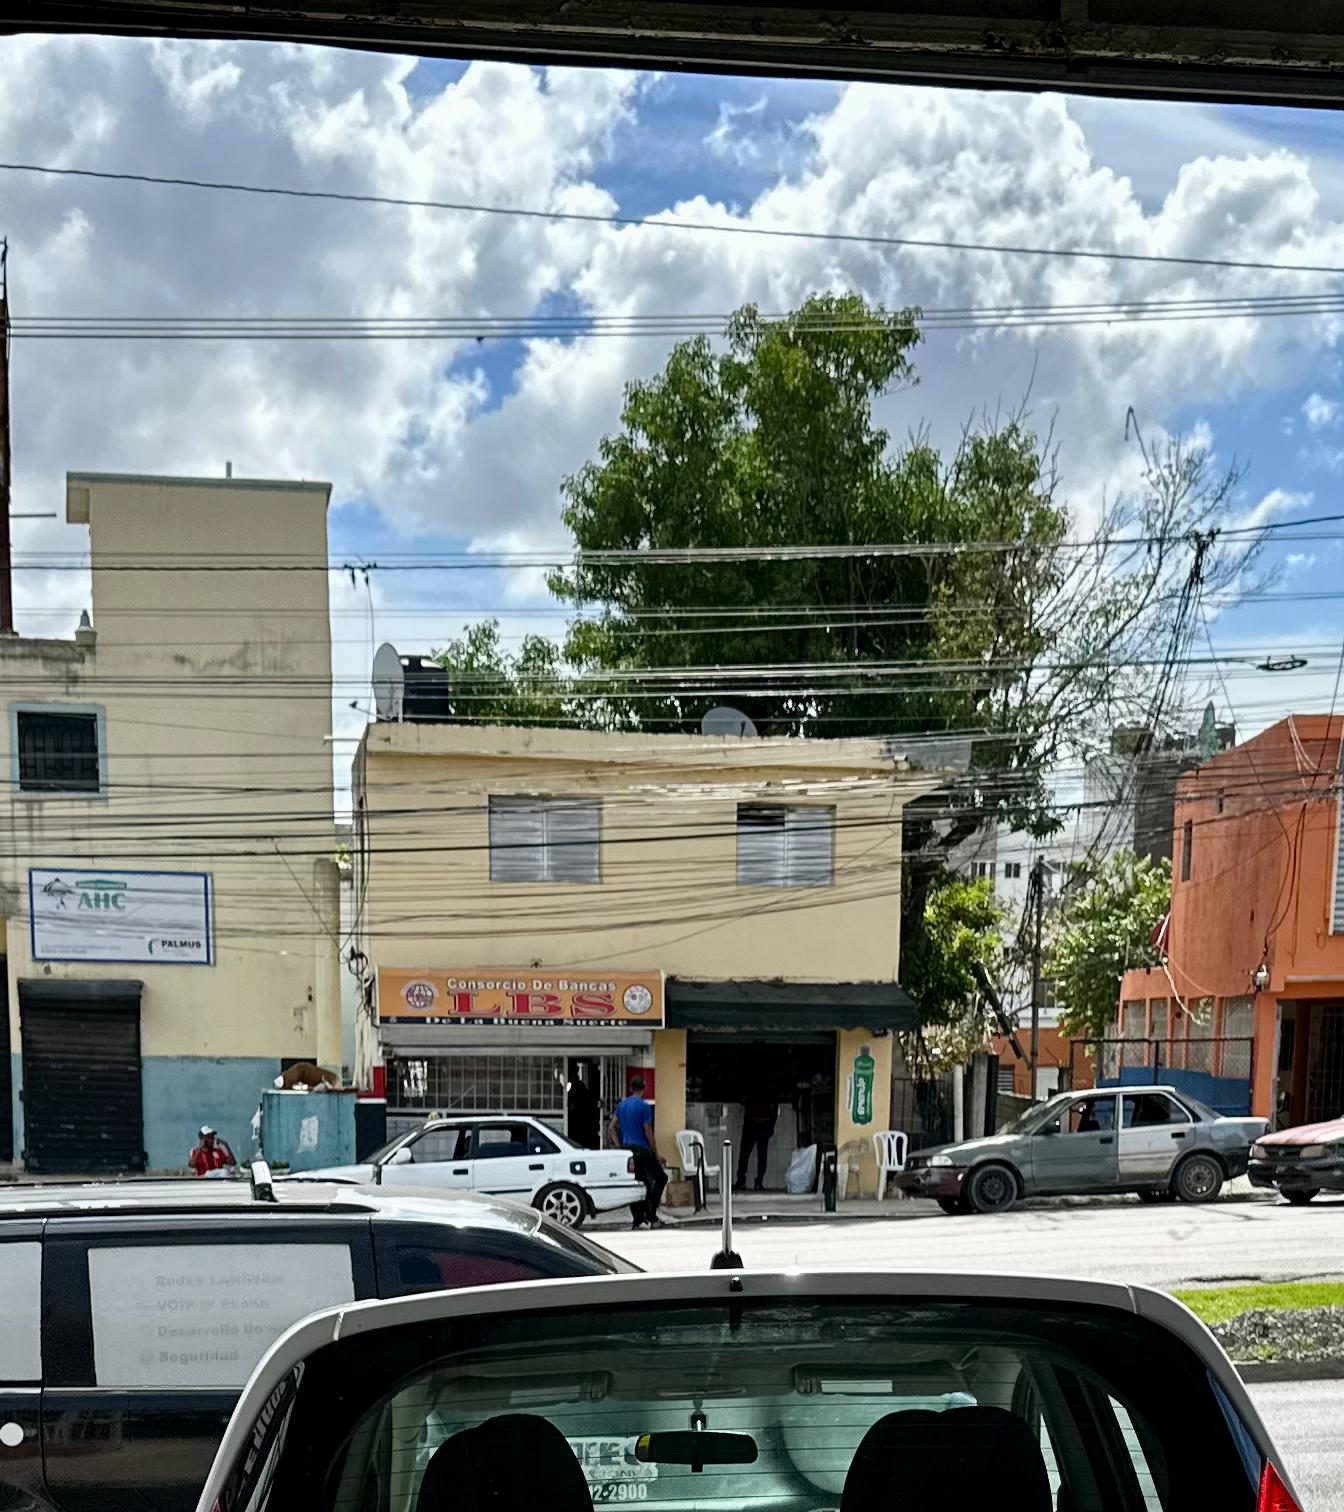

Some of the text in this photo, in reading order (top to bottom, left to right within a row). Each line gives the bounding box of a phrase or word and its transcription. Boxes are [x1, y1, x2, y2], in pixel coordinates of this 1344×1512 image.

[78, 892, 127, 910] AHC
[161, 939, 201, 949] PALMUS
[446, 977, 617, 992] Consorcio De Bancas
[447, 990, 617, 1017] LBS
